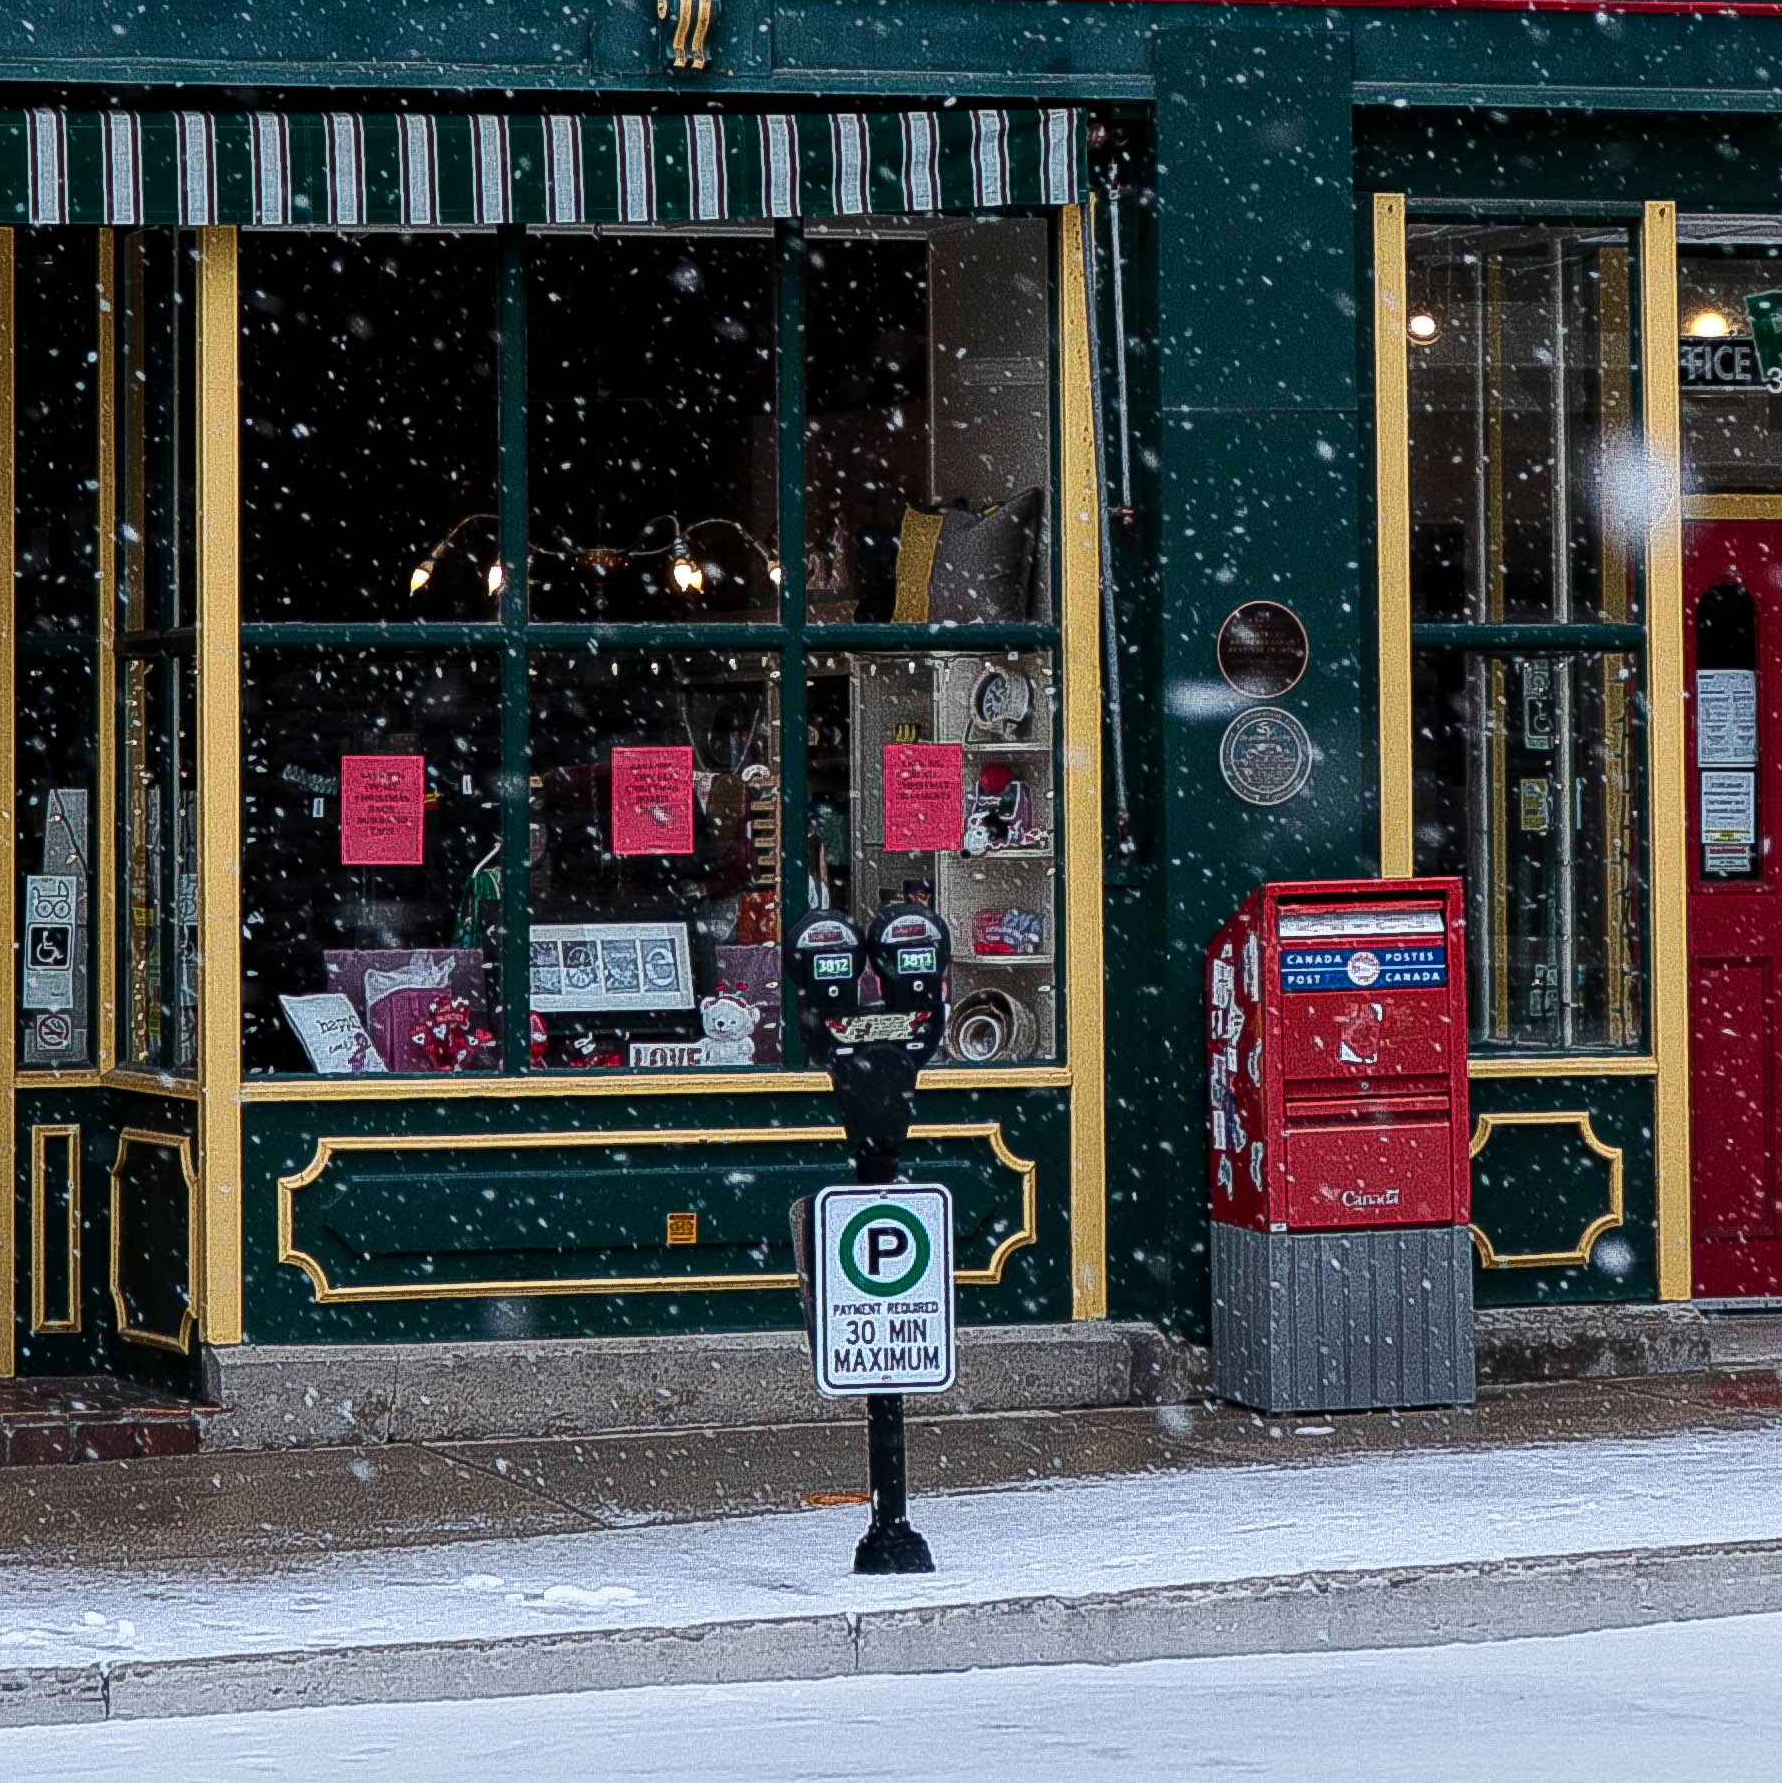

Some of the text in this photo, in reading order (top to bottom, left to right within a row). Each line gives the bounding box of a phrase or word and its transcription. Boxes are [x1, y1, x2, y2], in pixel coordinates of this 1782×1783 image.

[1286, 954, 1343, 965] CANADA
[1384, 951, 1434, 962] POSTES
[817, 959, 849, 974] 3812
[1287, 974, 1321, 985] POST
[1384, 972, 1441, 982] CANADA
[867, 1226, 909, 1276] P
[832, 1301, 940, 1316] PAYMENT REQUIRED
[845, 1318, 928, 1345] 30 MIN
[833, 1346, 941, 1373] MAXIMUM
